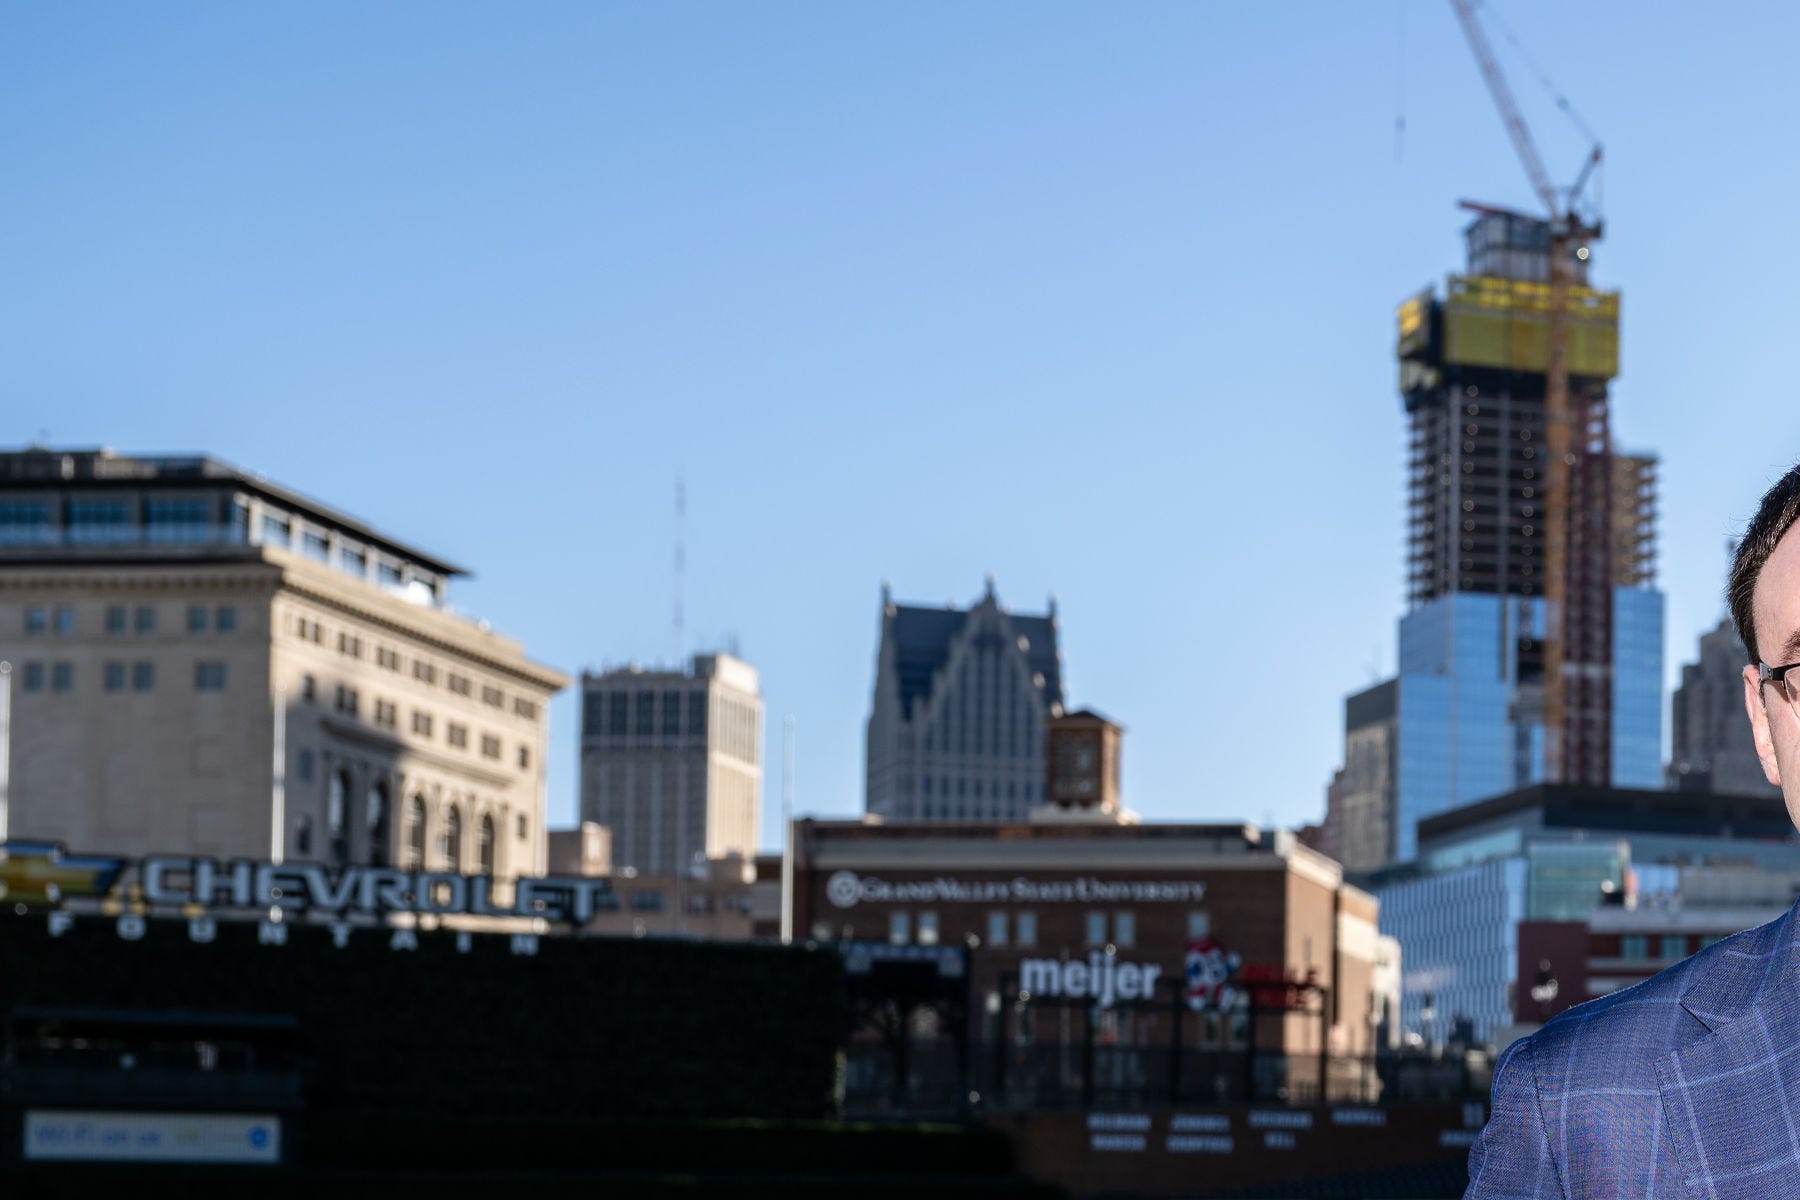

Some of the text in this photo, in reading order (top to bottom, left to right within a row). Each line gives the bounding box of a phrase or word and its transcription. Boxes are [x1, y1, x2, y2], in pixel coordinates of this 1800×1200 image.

[143, 858, 605, 922] CHEVROLET
[48, 914, 539, 955] FOUNTAIN
[1020, 950, 1162, 1008] meijer
